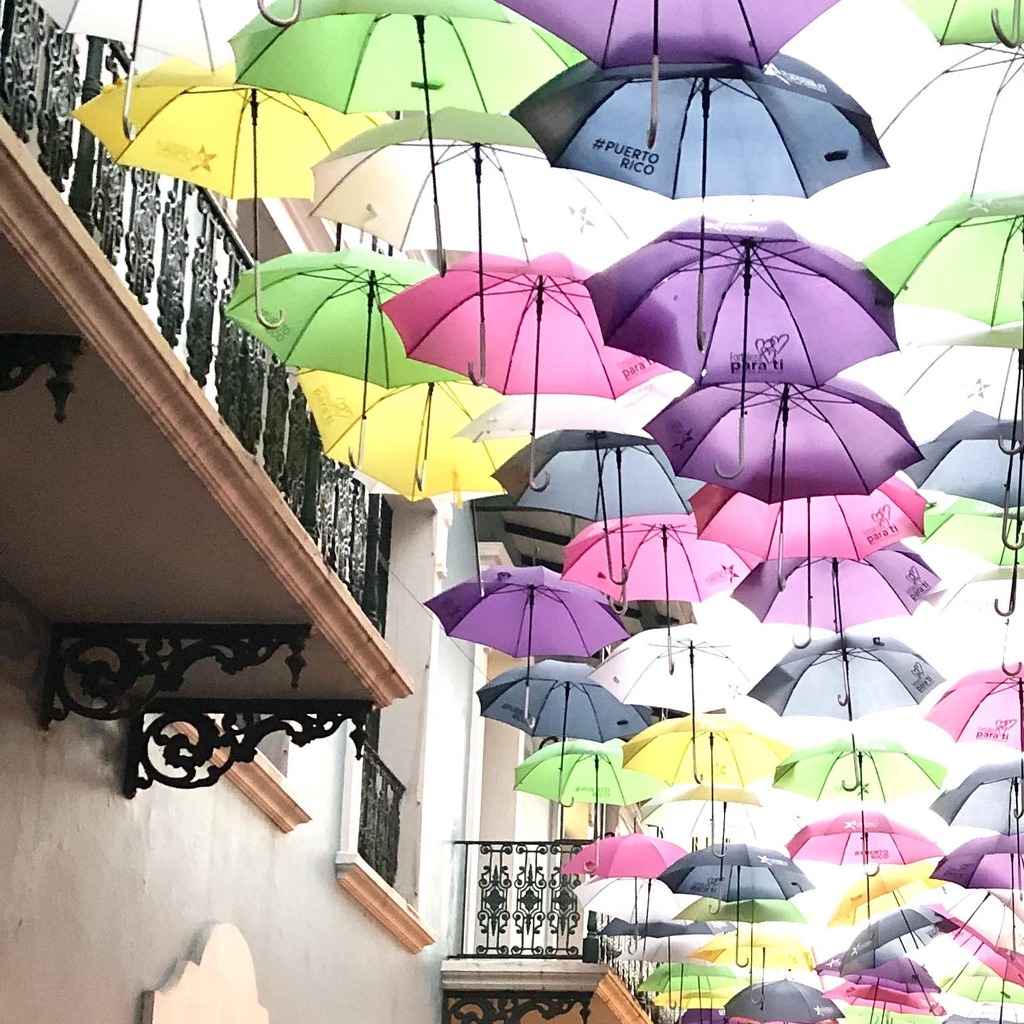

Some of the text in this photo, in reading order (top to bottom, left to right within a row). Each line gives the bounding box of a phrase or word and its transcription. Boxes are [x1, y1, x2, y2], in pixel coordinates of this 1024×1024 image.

[592, 137, 660, 165] #PUERTO
[619, 156, 655, 176] RICO
[621, 362, 646, 381] para
[772, 358, 784, 371] ti
[866, 524, 899, 546] para ti
[976, 730, 999, 740] para
